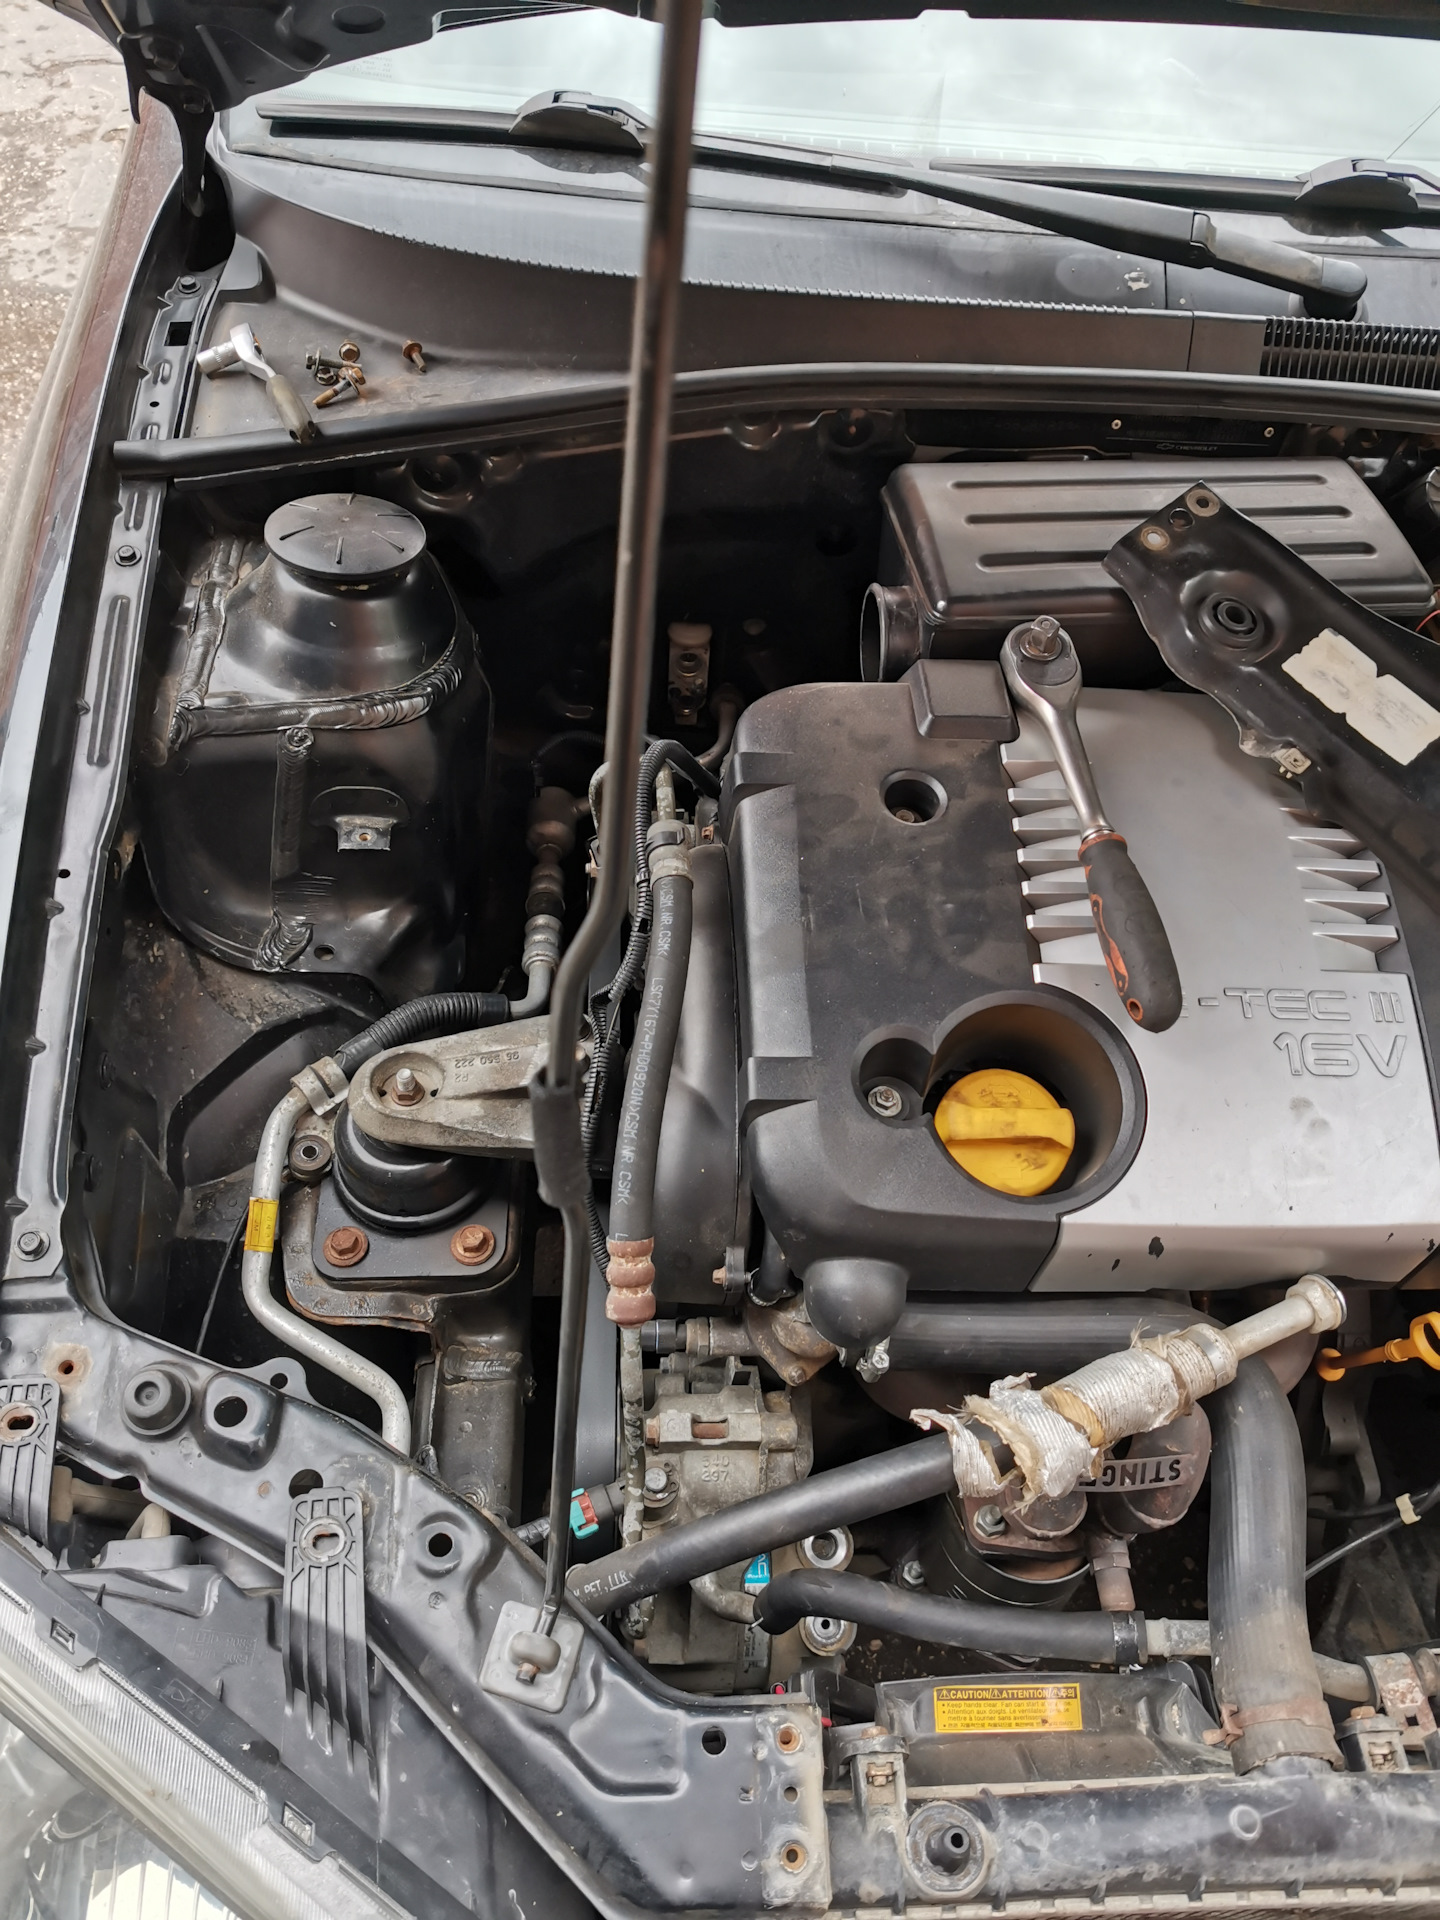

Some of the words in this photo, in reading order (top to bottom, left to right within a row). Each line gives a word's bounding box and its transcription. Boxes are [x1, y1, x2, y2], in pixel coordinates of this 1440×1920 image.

[1368, 991, 1404, 1022] III
[455, 1058, 475, 1068] 222
[1273, 1031, 1407, 1078] 16V
